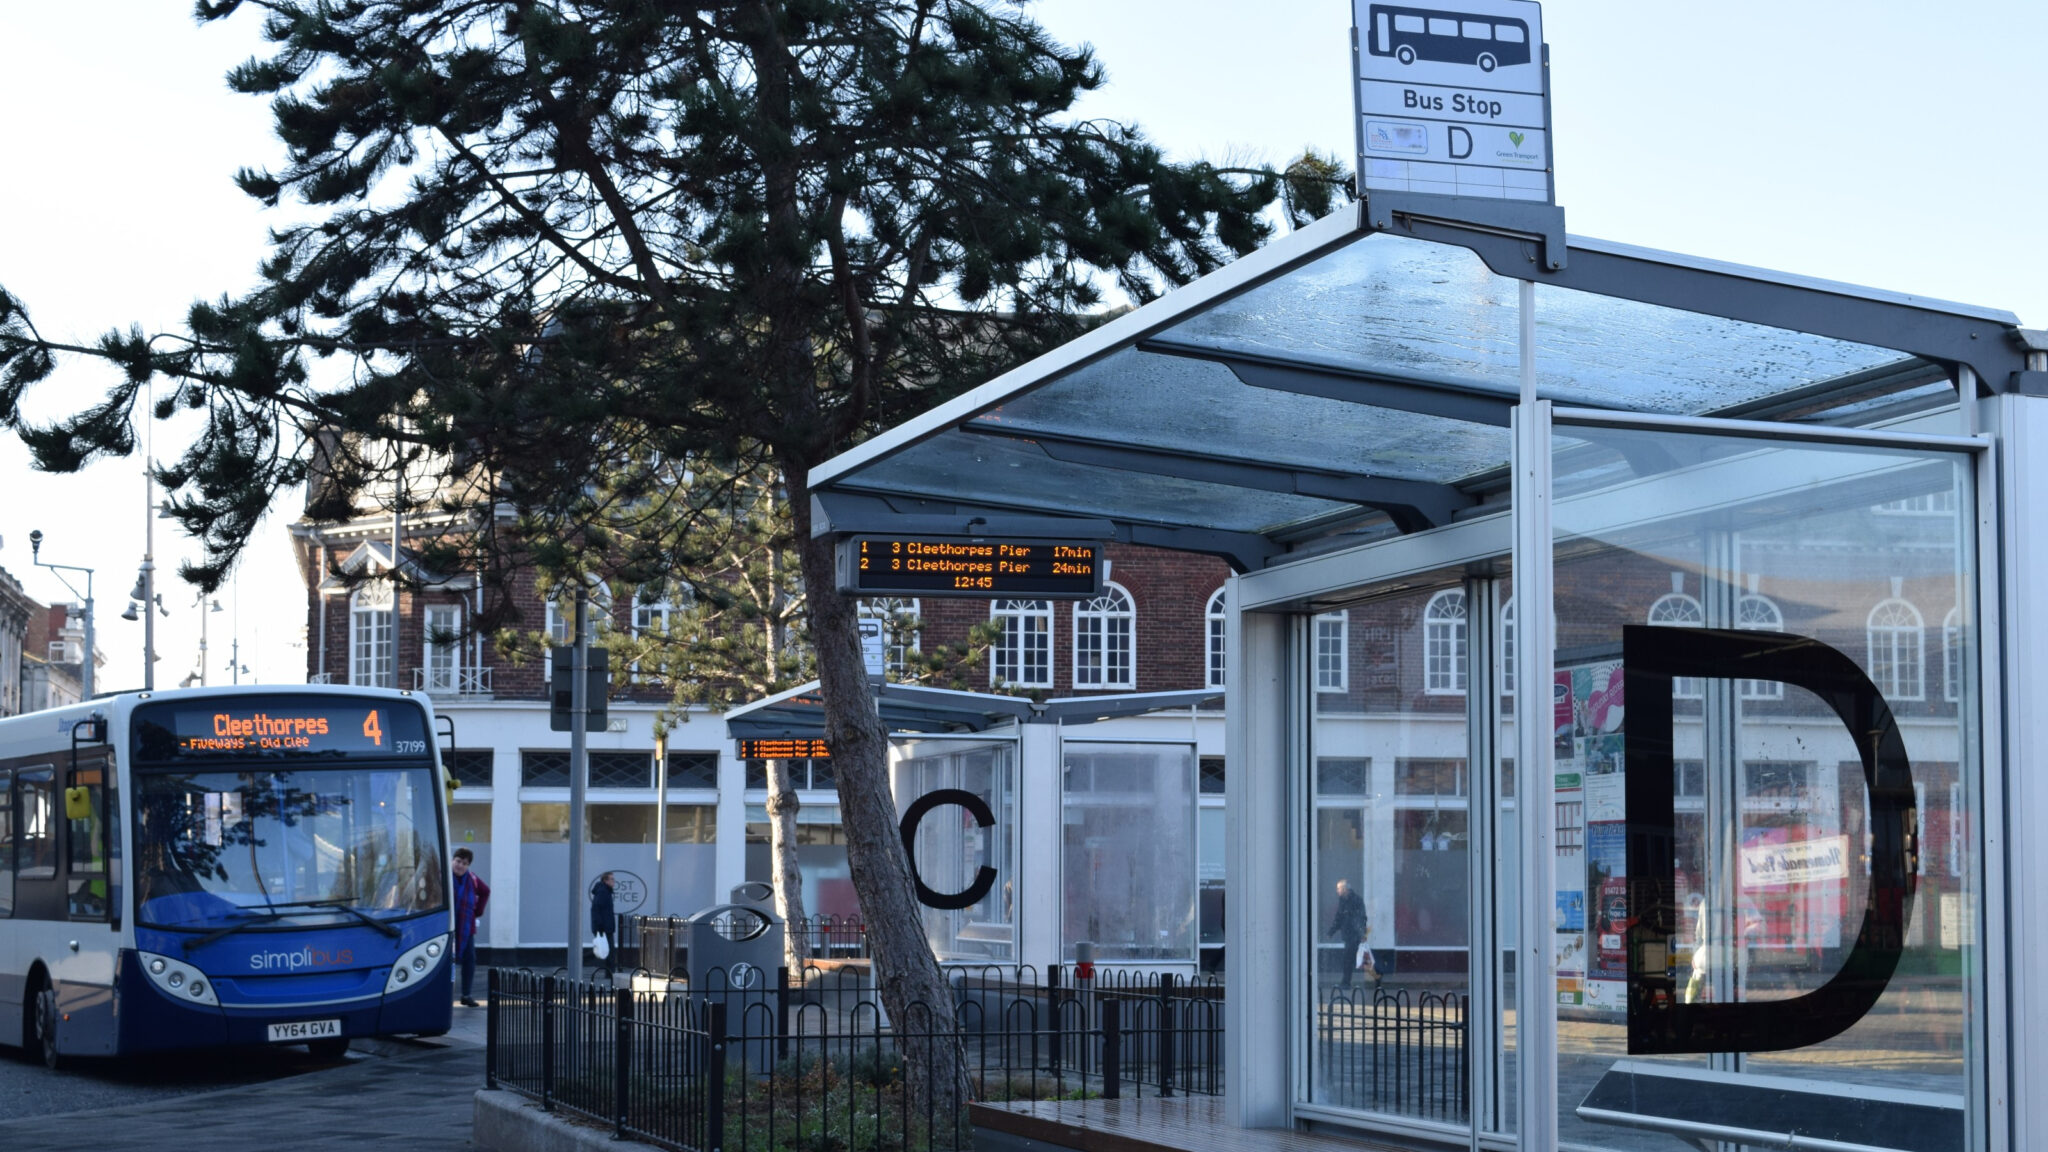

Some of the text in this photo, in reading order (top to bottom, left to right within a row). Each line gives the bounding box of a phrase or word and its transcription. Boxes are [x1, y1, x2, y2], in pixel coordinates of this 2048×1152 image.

[1403, 89, 1502, 119] Bus Stop
[1447, 125, 1473, 160] D
[861, 541, 1092, 559] 1 3 Cleethorpes Pier 17min
[860, 558, 1092, 574] 2 3 Cleethorpes Pier 24min
[954, 576, 993, 588] 12:45
[213, 709, 382, 746] Cleethorpes 4
[260, 737, 281, 748] Old
[283, 736, 310, 748] Clee
[395, 741, 426, 753] 37199
[899, 789, 998, 910] C
[1623, 625, 1918, 1055] D
[250, 945, 353, 971] simplibus
[273, 1021, 336, 1038] YY64 GVA
